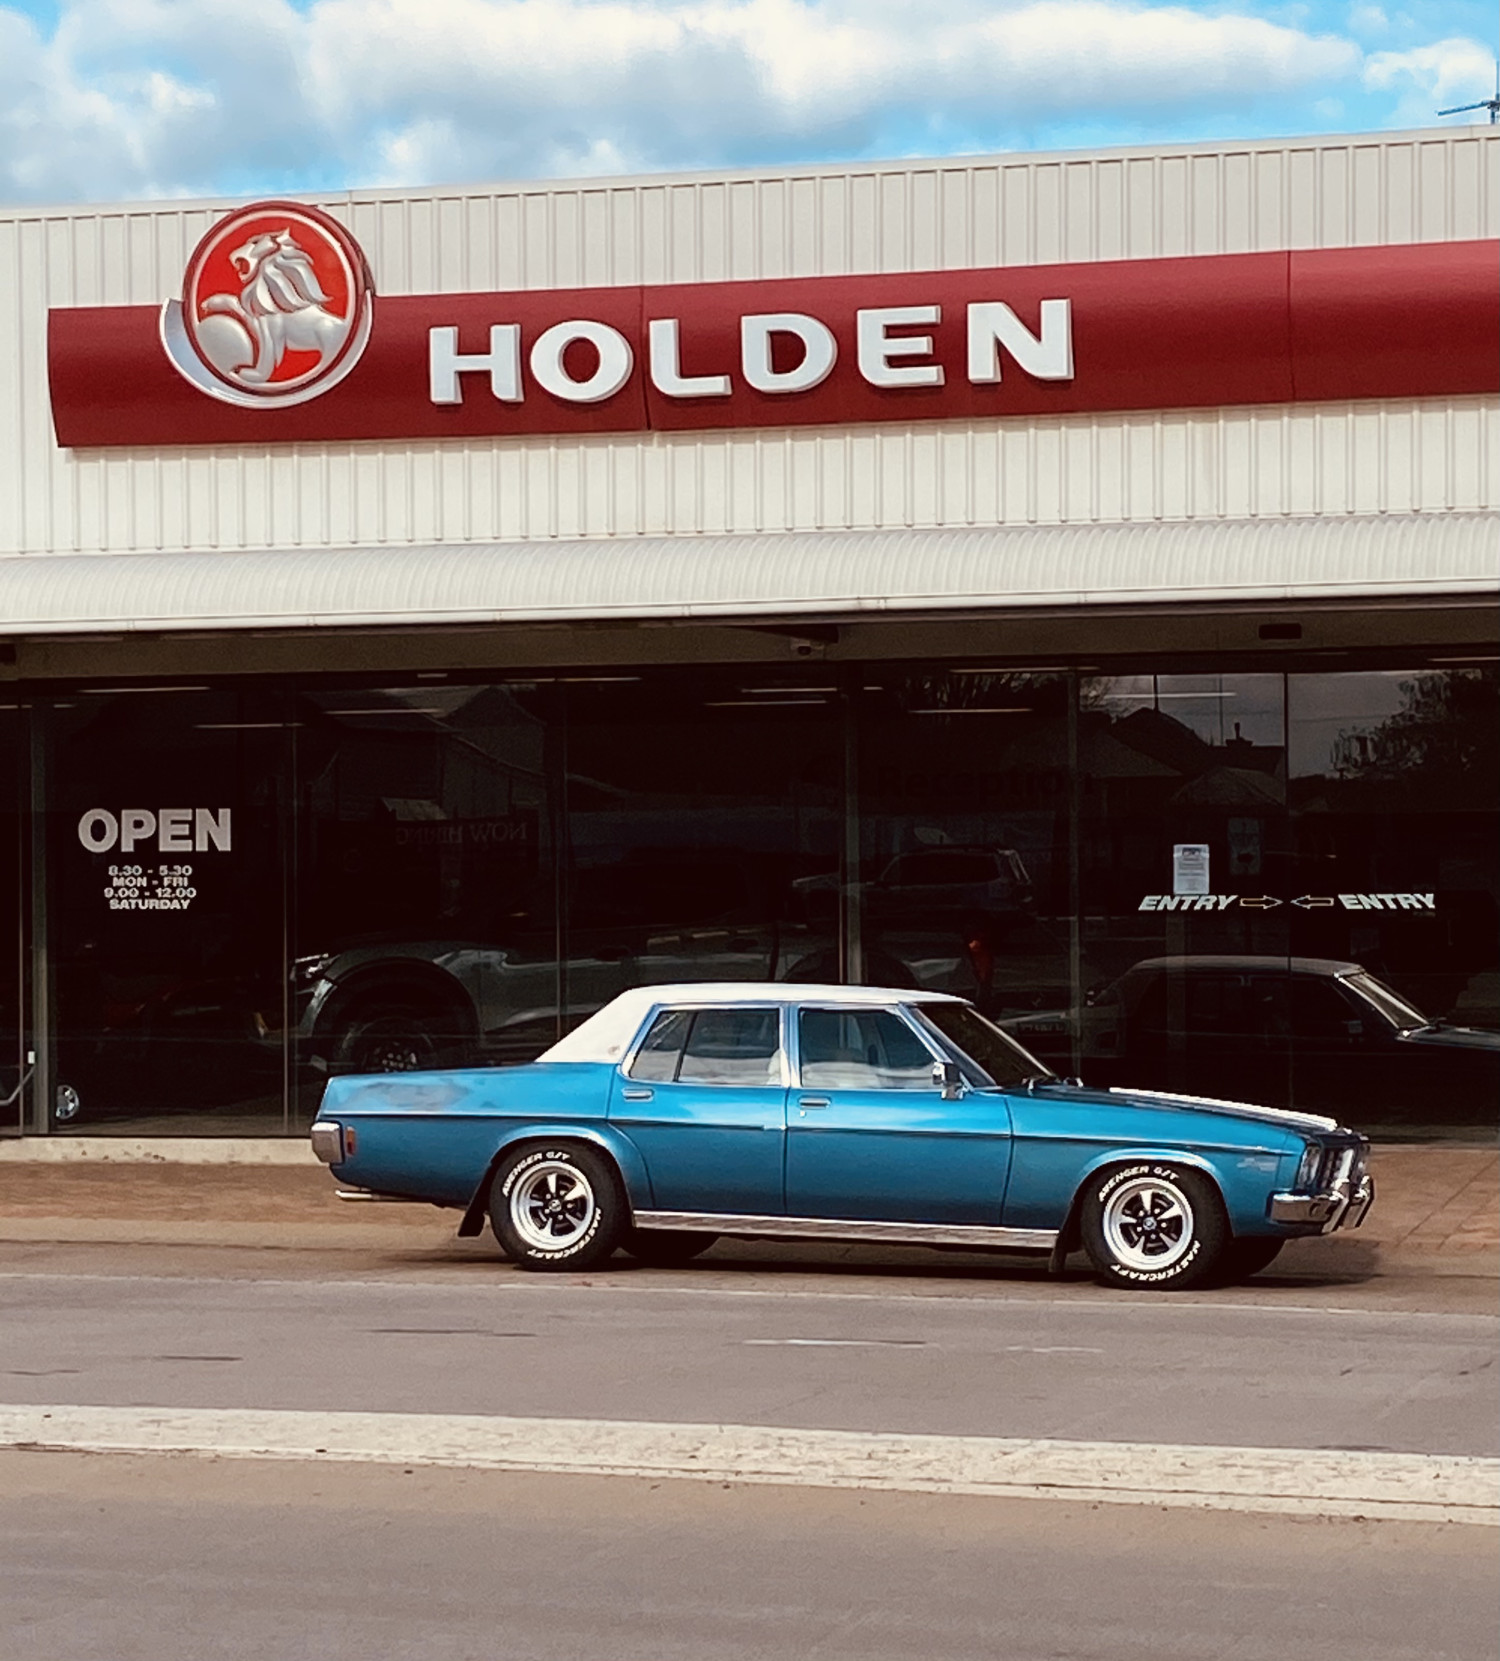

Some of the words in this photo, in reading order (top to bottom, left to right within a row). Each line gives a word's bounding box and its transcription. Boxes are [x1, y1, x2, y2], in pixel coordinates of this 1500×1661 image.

[428, 298, 1074, 405] HOLDEN
[78, 808, 232, 853] OPEN
[108, 865, 142, 876] 8.30
[159, 865, 193, 876] 5.30
[112, 877, 147, 887] MON
[163, 877, 188, 887] FRI
[104, 887, 139, 898] 9.00
[155, 887, 197, 898] 12.00
[109, 899, 191, 910] SATURDAY
[1138, 895, 1238, 911] ENTRY
[1338, 893, 1436, 909] ENTRY
[502, 1152, 542, 1197] AVENGER
[1098, 1165, 1149, 1202] AVENGER
[1110, 1240, 1201, 1281] MASTERCRAFT
